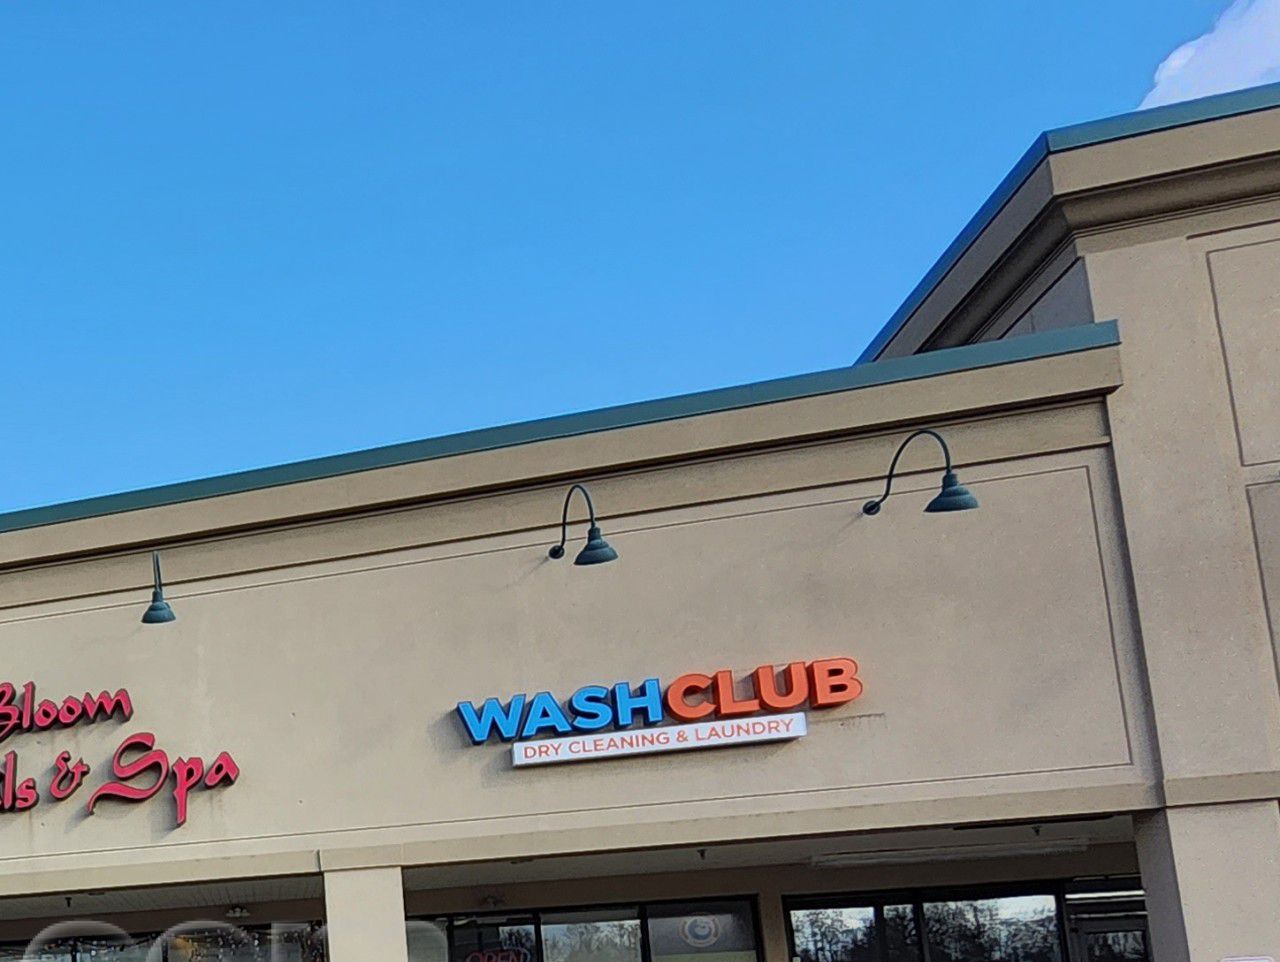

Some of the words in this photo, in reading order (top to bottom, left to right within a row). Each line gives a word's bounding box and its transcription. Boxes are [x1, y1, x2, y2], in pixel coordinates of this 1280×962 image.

[523, 743, 563, 760] DRY
[569, 729, 670, 755] CLEANING
[677, 727, 689, 743] &
[694, 717, 796, 742] LAUNDRY
[49, 750, 90, 801] &
[86, 732, 240, 828] Spa
